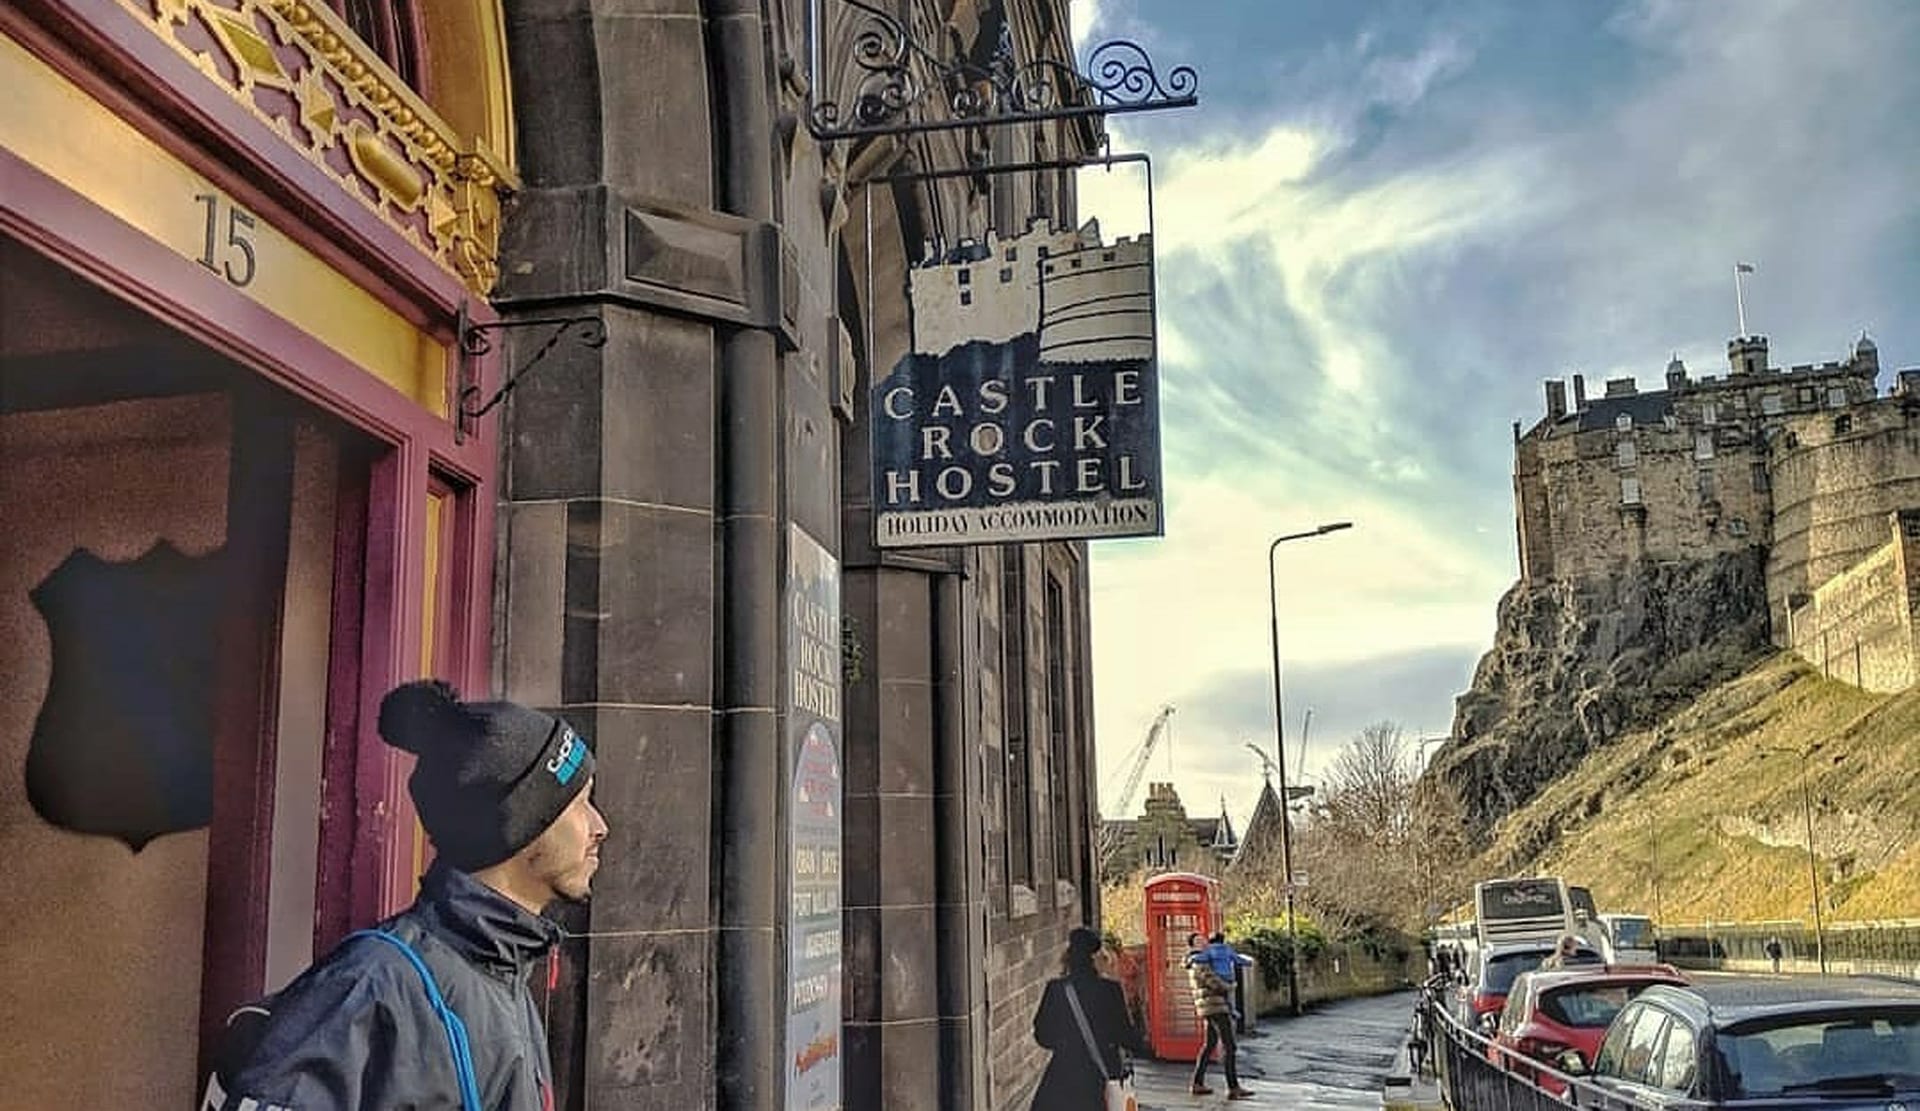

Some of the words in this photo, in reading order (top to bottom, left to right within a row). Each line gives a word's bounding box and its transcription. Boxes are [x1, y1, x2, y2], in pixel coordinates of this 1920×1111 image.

[195, 194, 256, 288] 15
[884, 371, 1141, 420] CASTLE
[921, 415, 1107, 460] ROCK
[886, 456, 1146, 504] HOSTEL
[886, 514, 970, 537] HOLIDAY
[977, 503, 1148, 534] ACCOMMODATION
